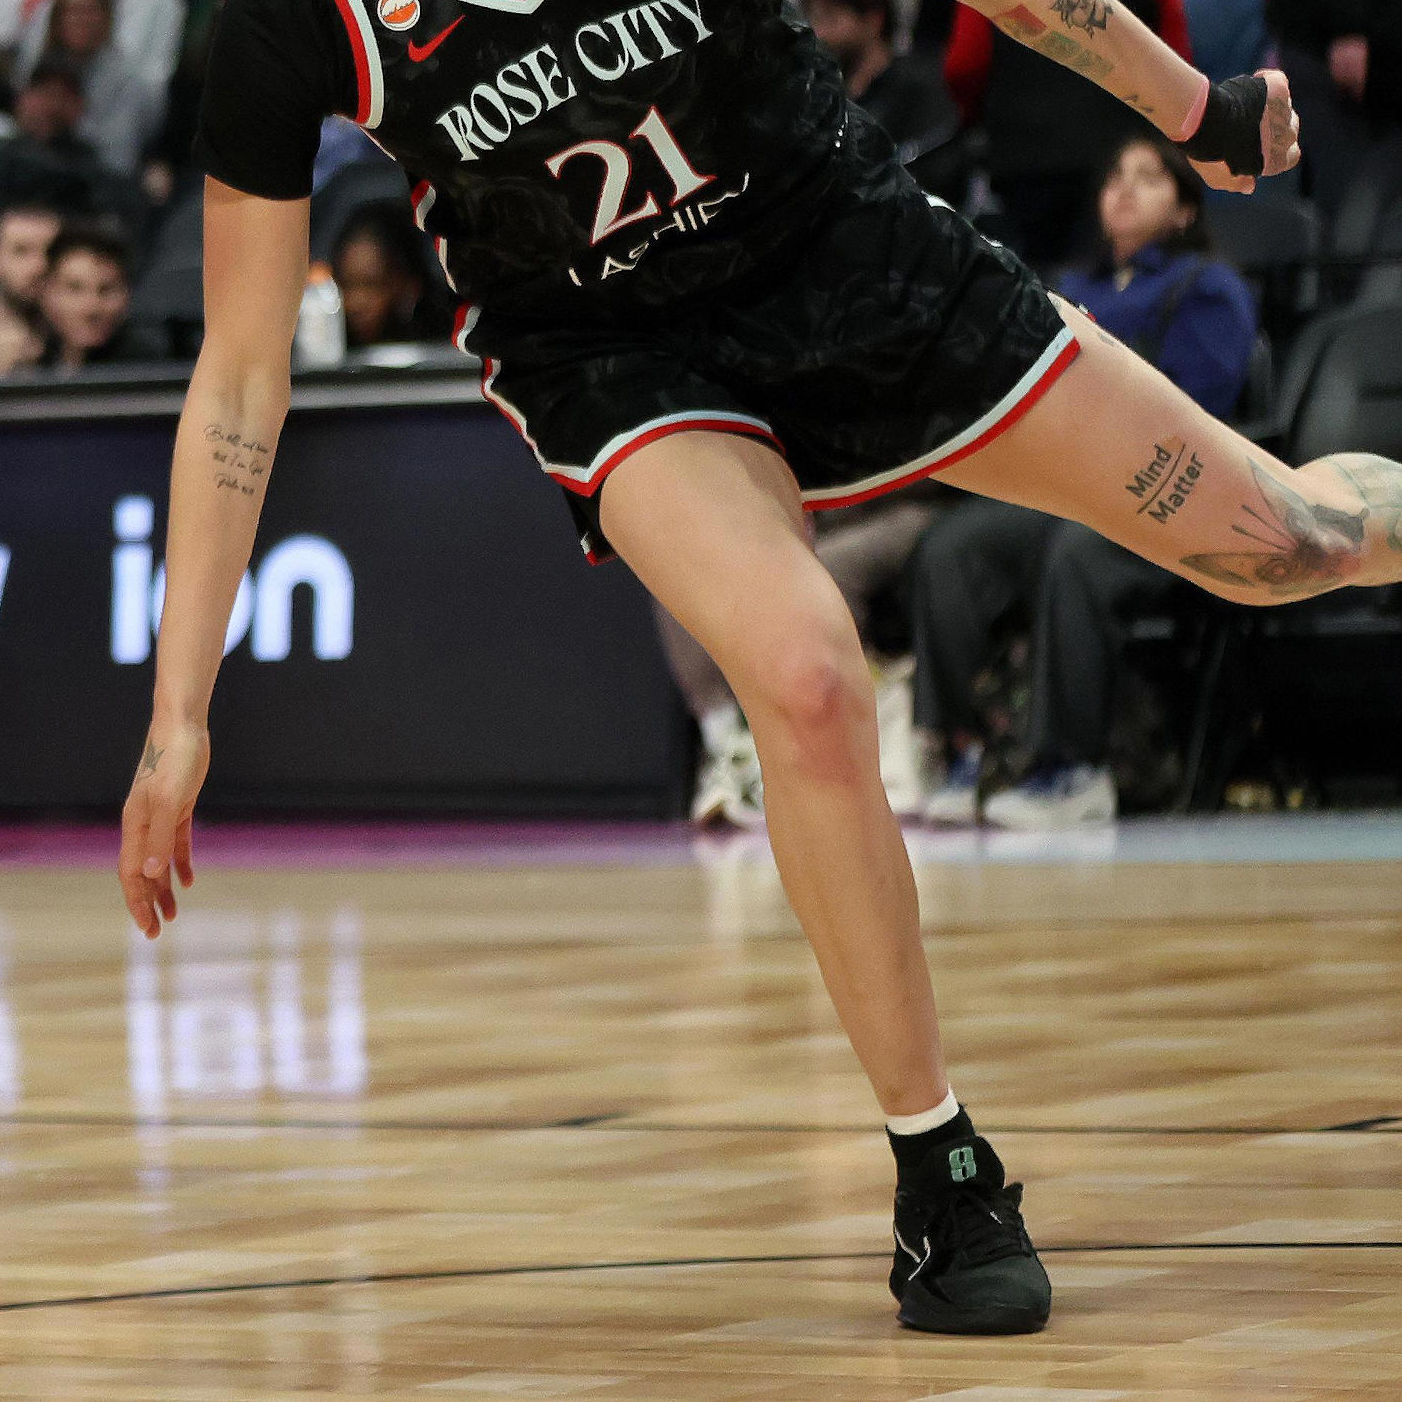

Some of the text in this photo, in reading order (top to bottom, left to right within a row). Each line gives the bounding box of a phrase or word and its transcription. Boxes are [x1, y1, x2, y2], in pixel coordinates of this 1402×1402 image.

[435, 44, 578, 162] ROSE
[544, 104, 719, 247] 21
[1125, 442, 1172, 498] Mind
[1148, 452, 1204, 525] Matter
